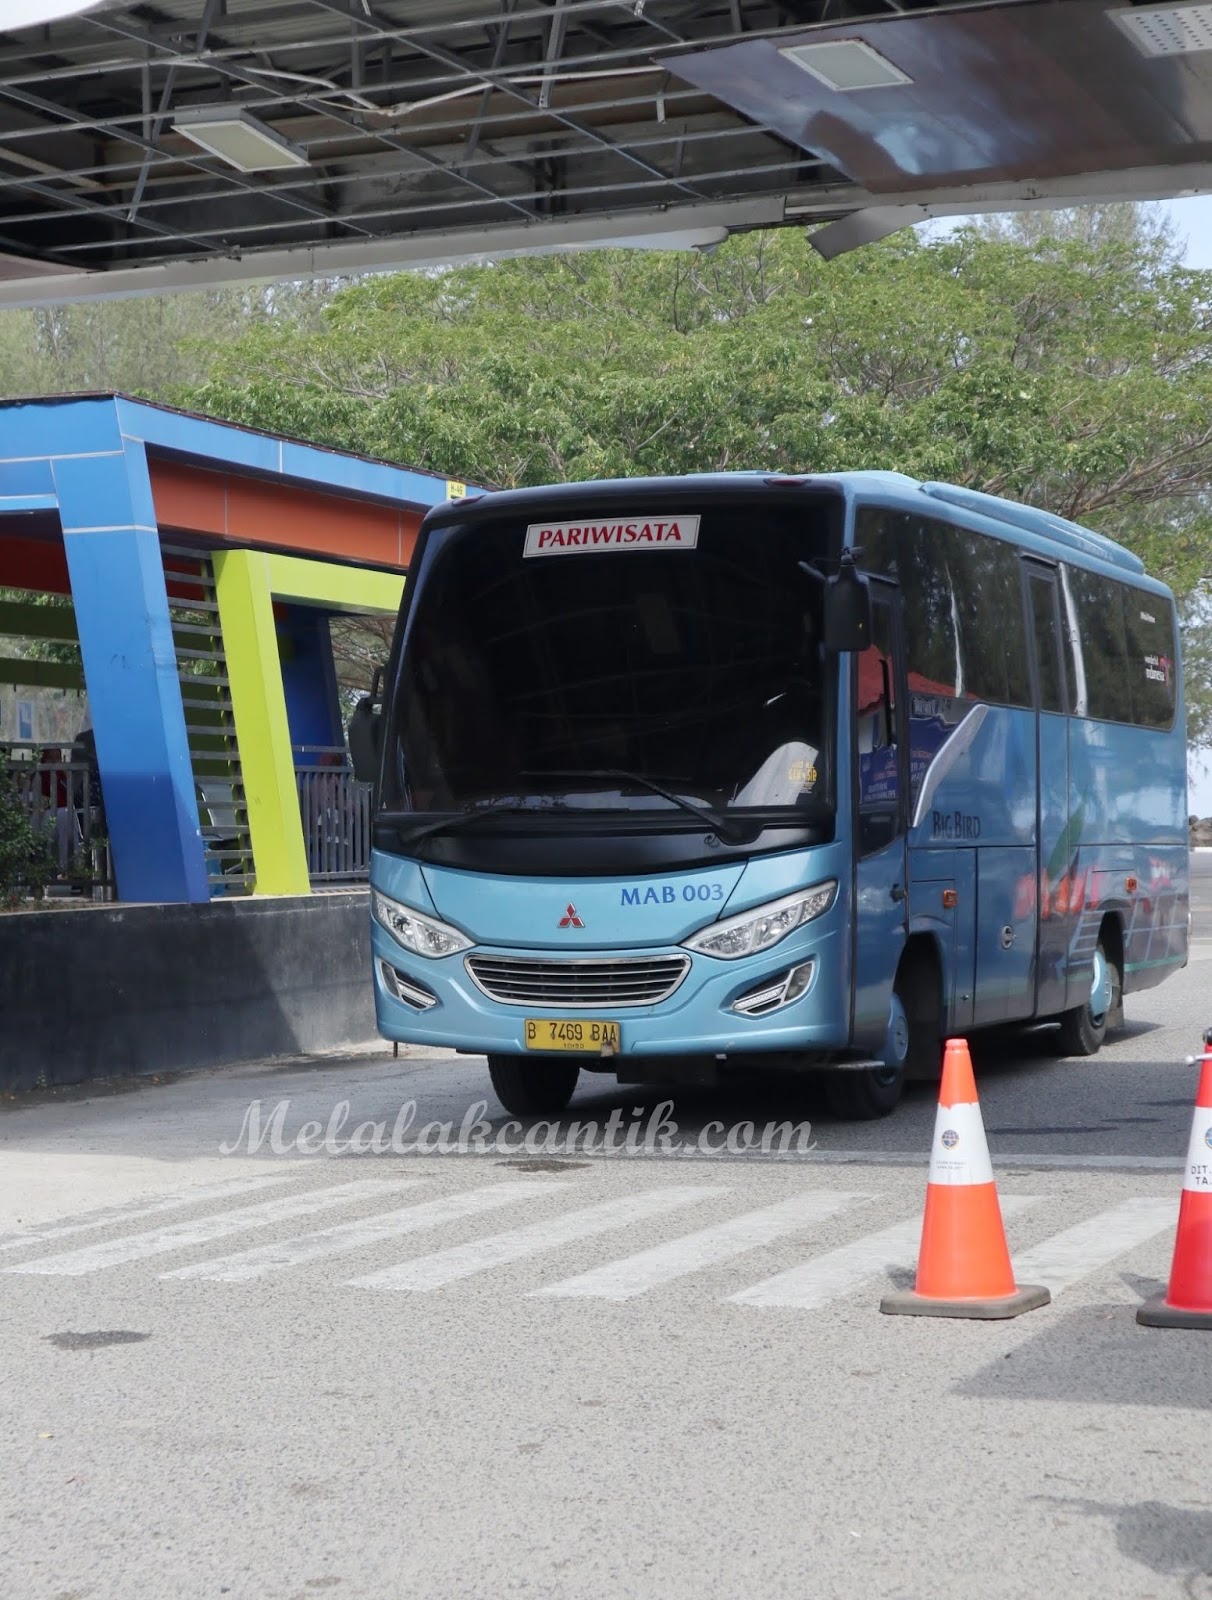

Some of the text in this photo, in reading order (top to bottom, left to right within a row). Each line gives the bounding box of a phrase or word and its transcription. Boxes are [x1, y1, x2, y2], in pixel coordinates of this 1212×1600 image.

[538, 522, 682, 548] PARIWISATA
[933, 810, 981, 839] BIG BIRD
[621, 884, 724, 906] MAB 003
[527, 1022, 617, 1042] B 7469 BAA
